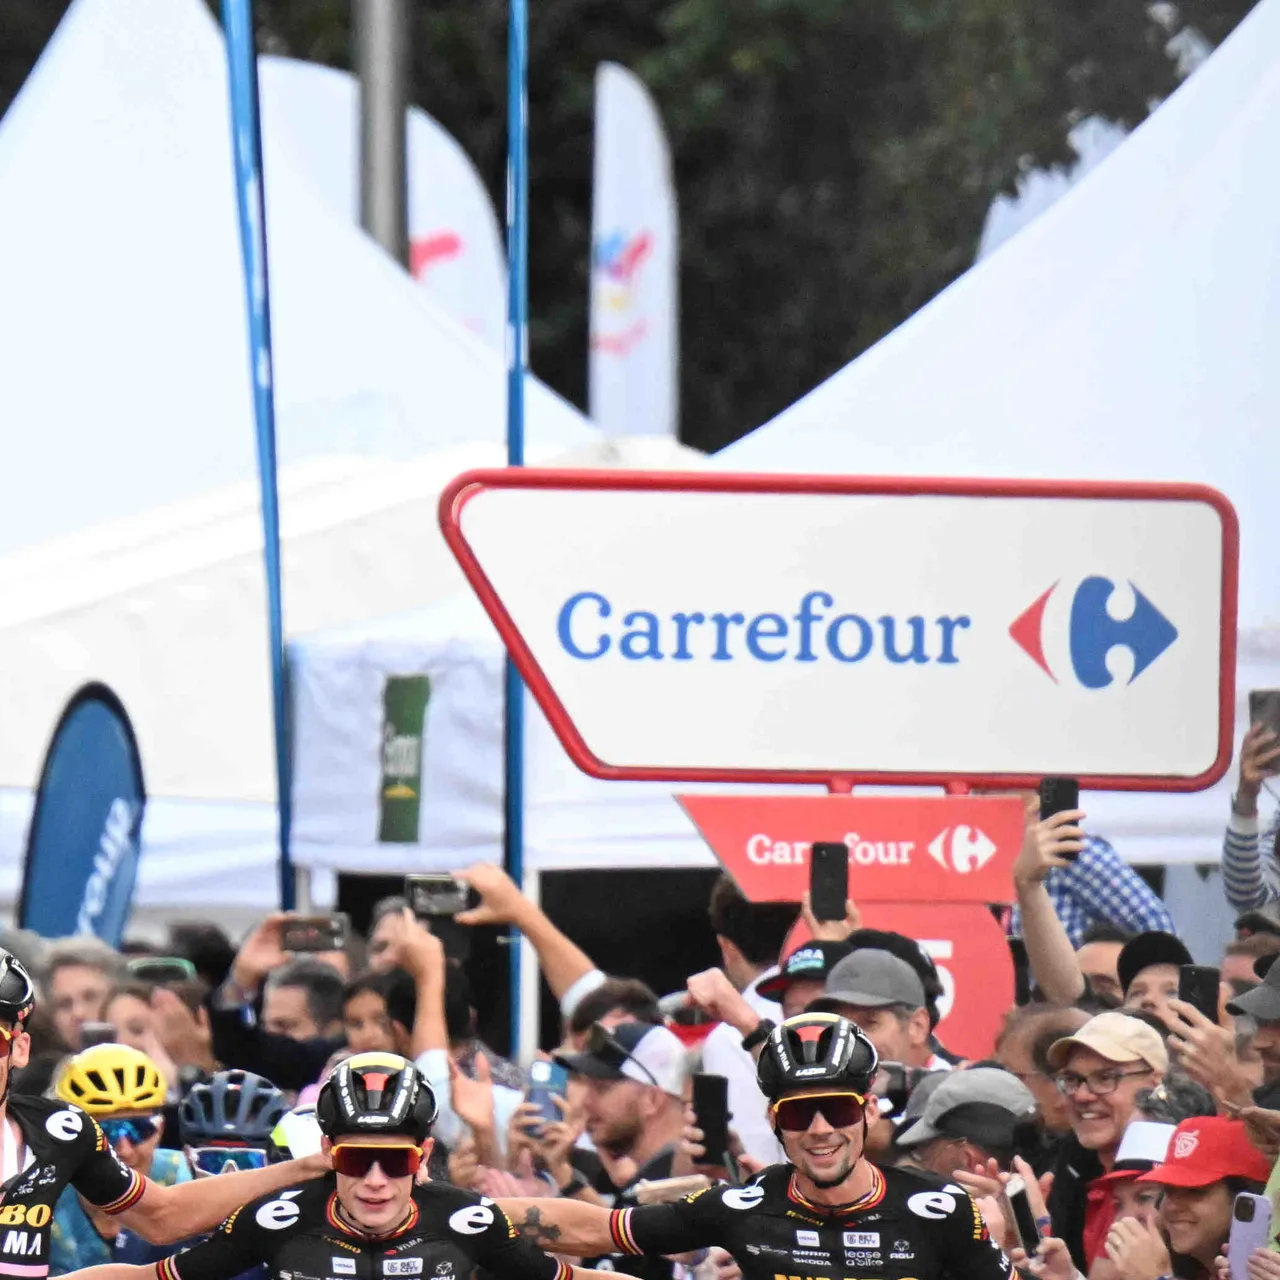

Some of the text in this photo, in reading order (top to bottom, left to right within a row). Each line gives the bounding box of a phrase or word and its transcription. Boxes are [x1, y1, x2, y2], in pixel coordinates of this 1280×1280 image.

[555, 589, 971, 666] Carrefour
[746, 832, 915, 868] Carfour
[397, 1237, 423, 1253] VISMA
[844, 1250, 881, 1259] lease
